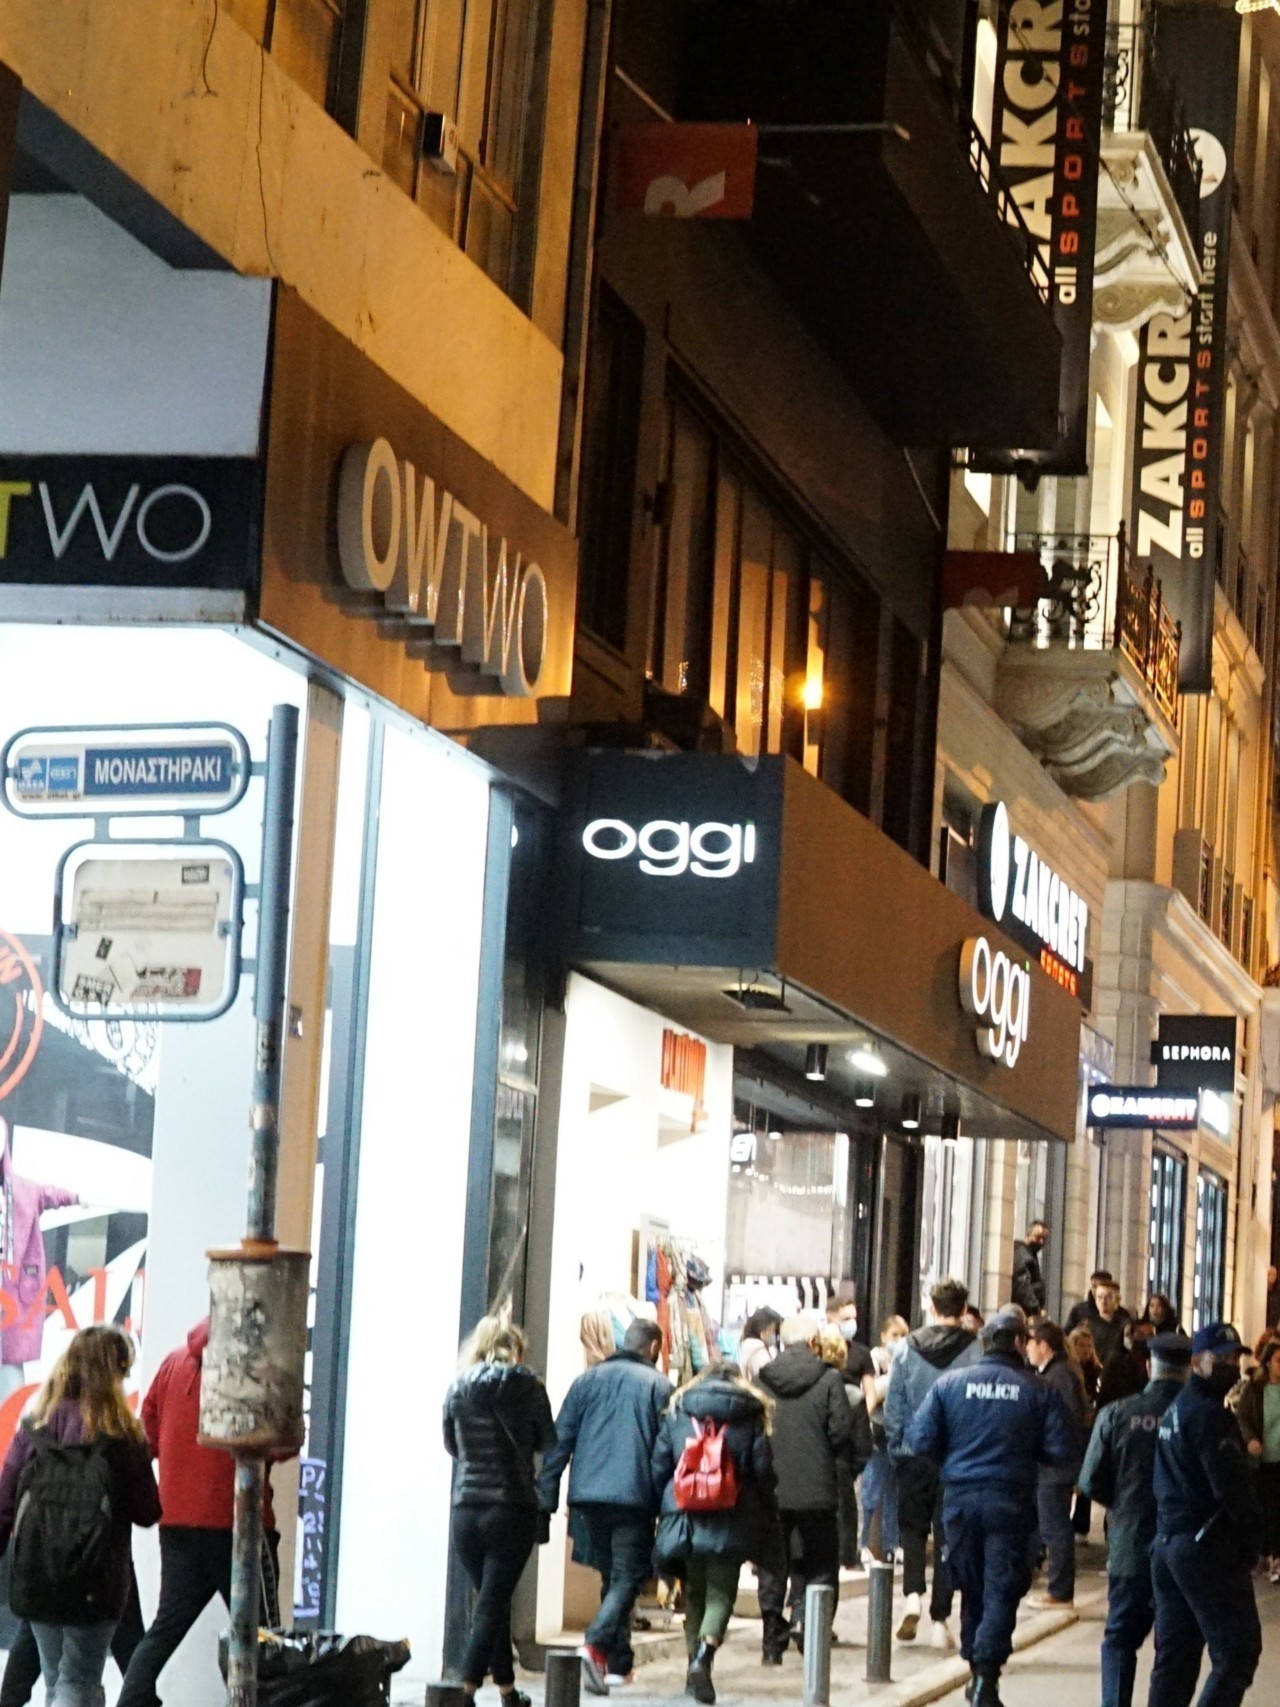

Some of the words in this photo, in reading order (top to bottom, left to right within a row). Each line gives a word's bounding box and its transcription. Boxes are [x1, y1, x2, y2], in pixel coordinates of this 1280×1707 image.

[1000, 0, 1064, 304] AKCR
[1059, 43, 1089, 255] SPORTS
[1054, 266, 1078, 304] all
[1198, 230, 1218, 286] here
[1189, 350, 1212, 519] SPORTS
[360, 435, 548, 697] OWTWO
[1186, 527, 1204, 559] all
[94, 755, 222, 785] ΜΟΝΑΣΤΗΡΑΚΙ
[582, 818, 756, 878] oggi
[1011, 834, 1088, 973] ZAKCRET
[971, 936, 1030, 1069] oggi
[1162, 1045, 1231, 1061] SEPHORA
[965, 1381, 1021, 1401] POLICE
